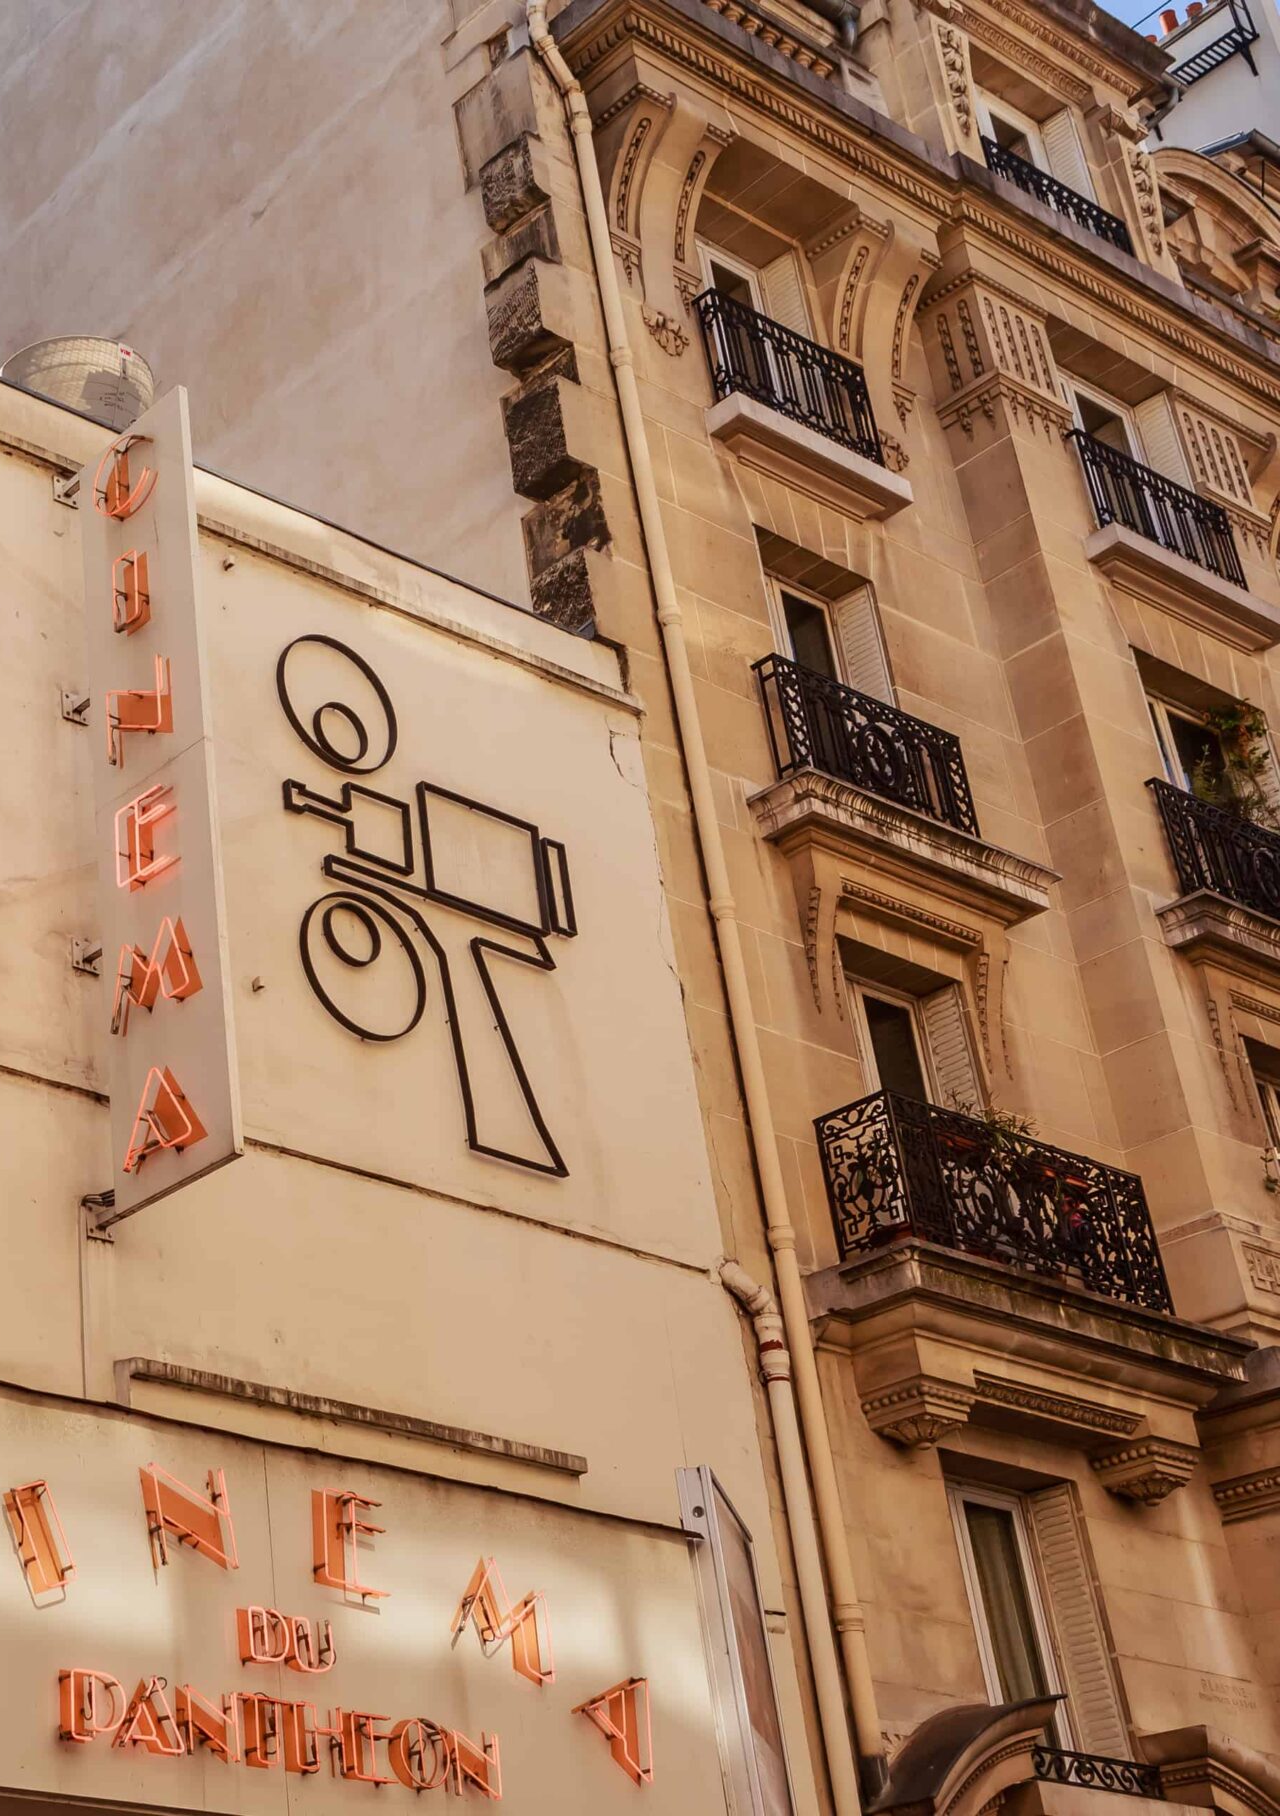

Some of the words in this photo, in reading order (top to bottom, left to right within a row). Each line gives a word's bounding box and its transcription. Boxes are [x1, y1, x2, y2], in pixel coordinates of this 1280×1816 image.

[93, 434, 209, 1175] CINEMA
[236, 1605, 337, 1675] DU
[58, 1668, 502, 1801] PANTHEON
